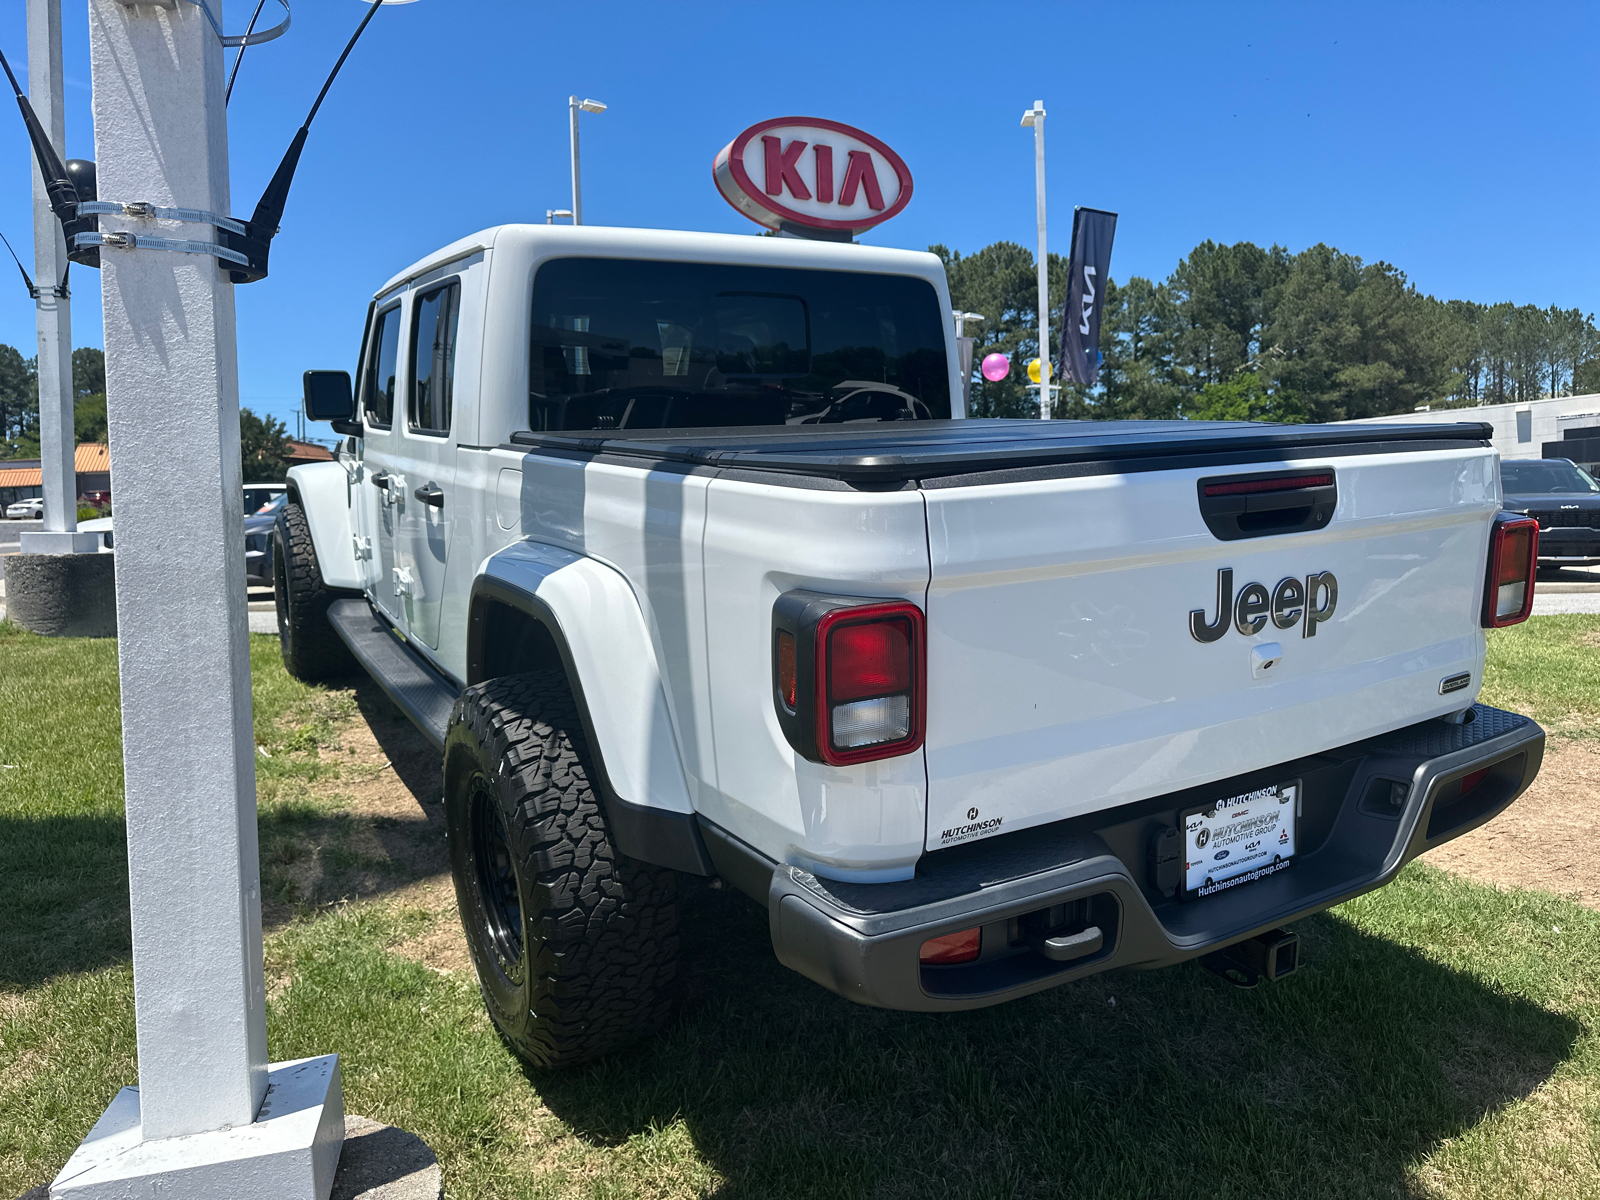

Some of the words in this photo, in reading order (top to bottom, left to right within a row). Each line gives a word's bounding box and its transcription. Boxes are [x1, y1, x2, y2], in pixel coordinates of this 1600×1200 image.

[761, 135, 885, 211] KIA
[1188, 567, 1339, 644] Jeep
[1442, 677, 1471, 690] OVERLAND
[1226, 785, 1278, 808] HUTCHINSON
[1231, 809, 1249, 819] GMC
[941, 817, 1003, 840] HUTCHINSON
[941, 832, 979, 845] AUTOMOTIVE
[980, 826, 1000, 836] GROUP
[1211, 810, 1280, 842] HUTCHINSON
[1212, 830, 1253, 849] AUTOMOTIVE
[1254, 824, 1277, 839] GROUP
[1207, 851, 1268, 874] HUTCHINSONAUTOGROUP.COM
[1198, 860, 1290, 897] Hutchinsonautogroup.com
